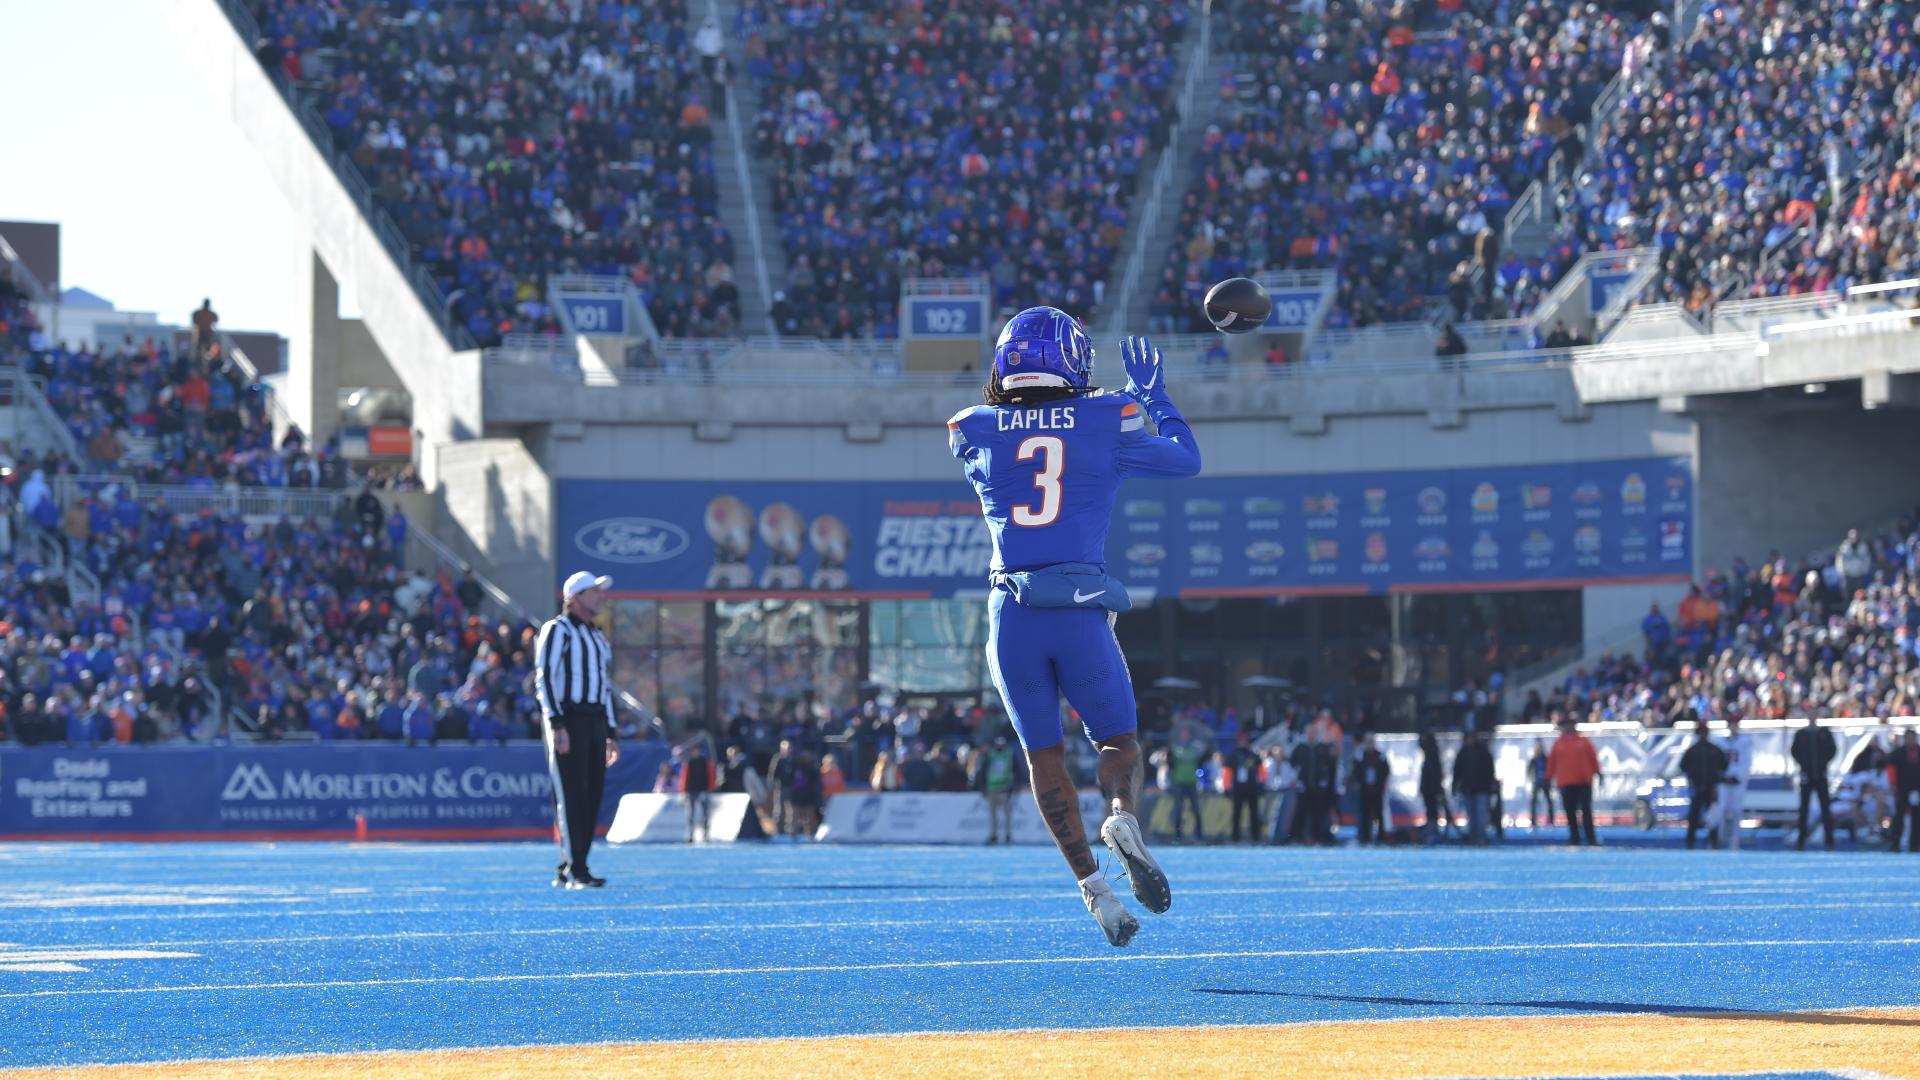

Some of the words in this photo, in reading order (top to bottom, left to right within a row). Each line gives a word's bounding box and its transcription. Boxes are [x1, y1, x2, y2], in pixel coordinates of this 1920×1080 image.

[574, 306, 608, 329] 101
[926, 308, 966, 332] 102
[998, 407, 1075, 432] CAPLES
[1012, 435, 1065, 527] 3
[597, 521, 667, 556] Ford
[877, 516, 991, 545] FIESTA
[875, 547, 993, 577] CHAMP
[16, 778, 101, 800] Roofing
[106, 778, 147, 796] and
[432, 767, 459, 798] &
[461, 766, 551, 798] COMP
